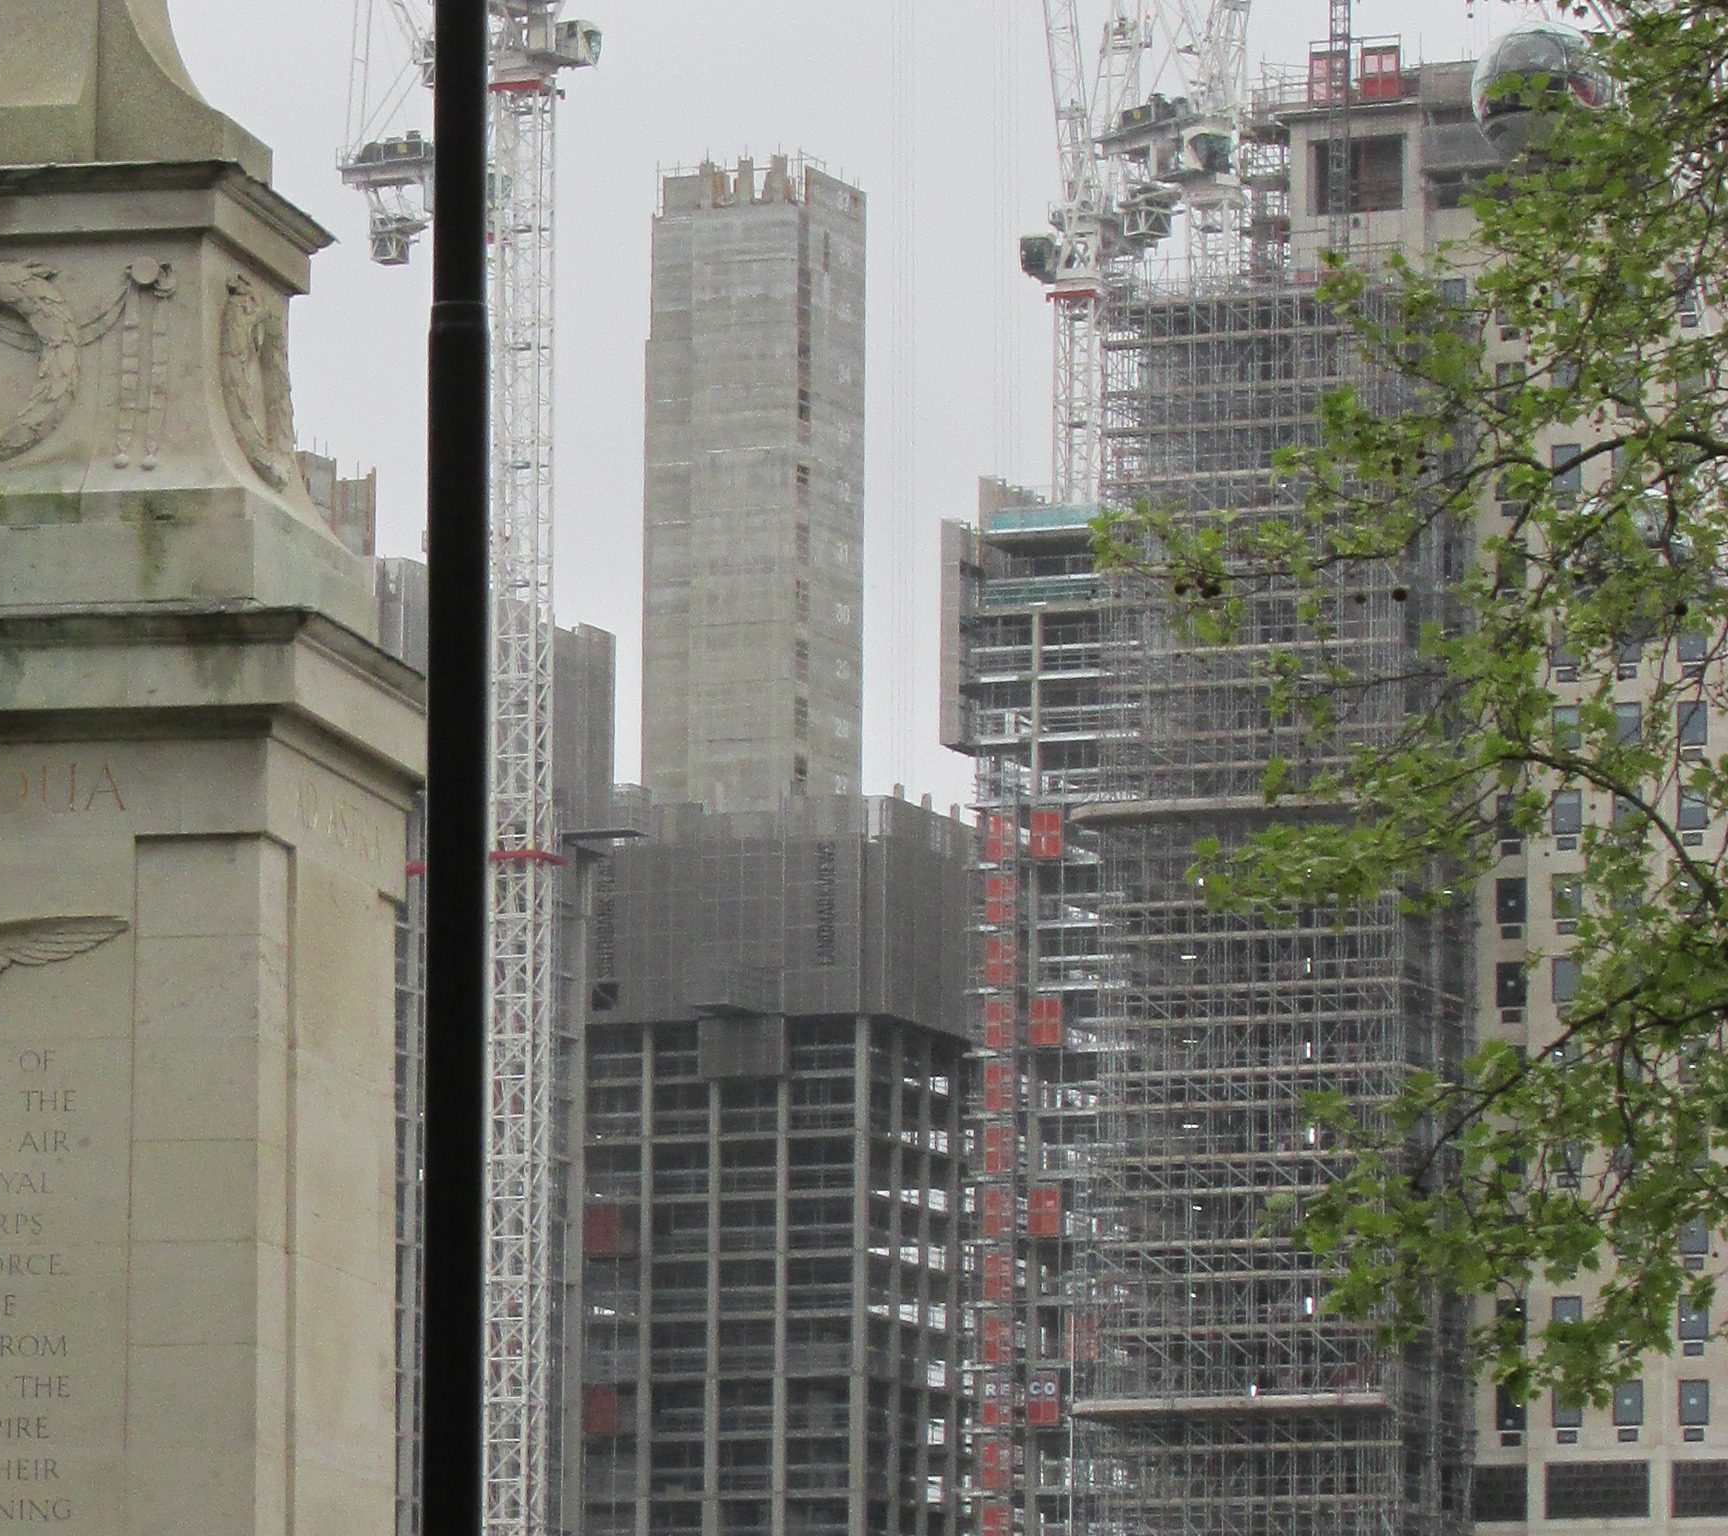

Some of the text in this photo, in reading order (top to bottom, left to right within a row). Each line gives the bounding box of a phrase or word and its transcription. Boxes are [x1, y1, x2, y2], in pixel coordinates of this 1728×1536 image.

[19, 1049, 56, 1072] OF
[20, 1089, 76, 1113] THE
[18, 1130, 71, 1153] AIR
[14, 1375, 71, 1399] THE
